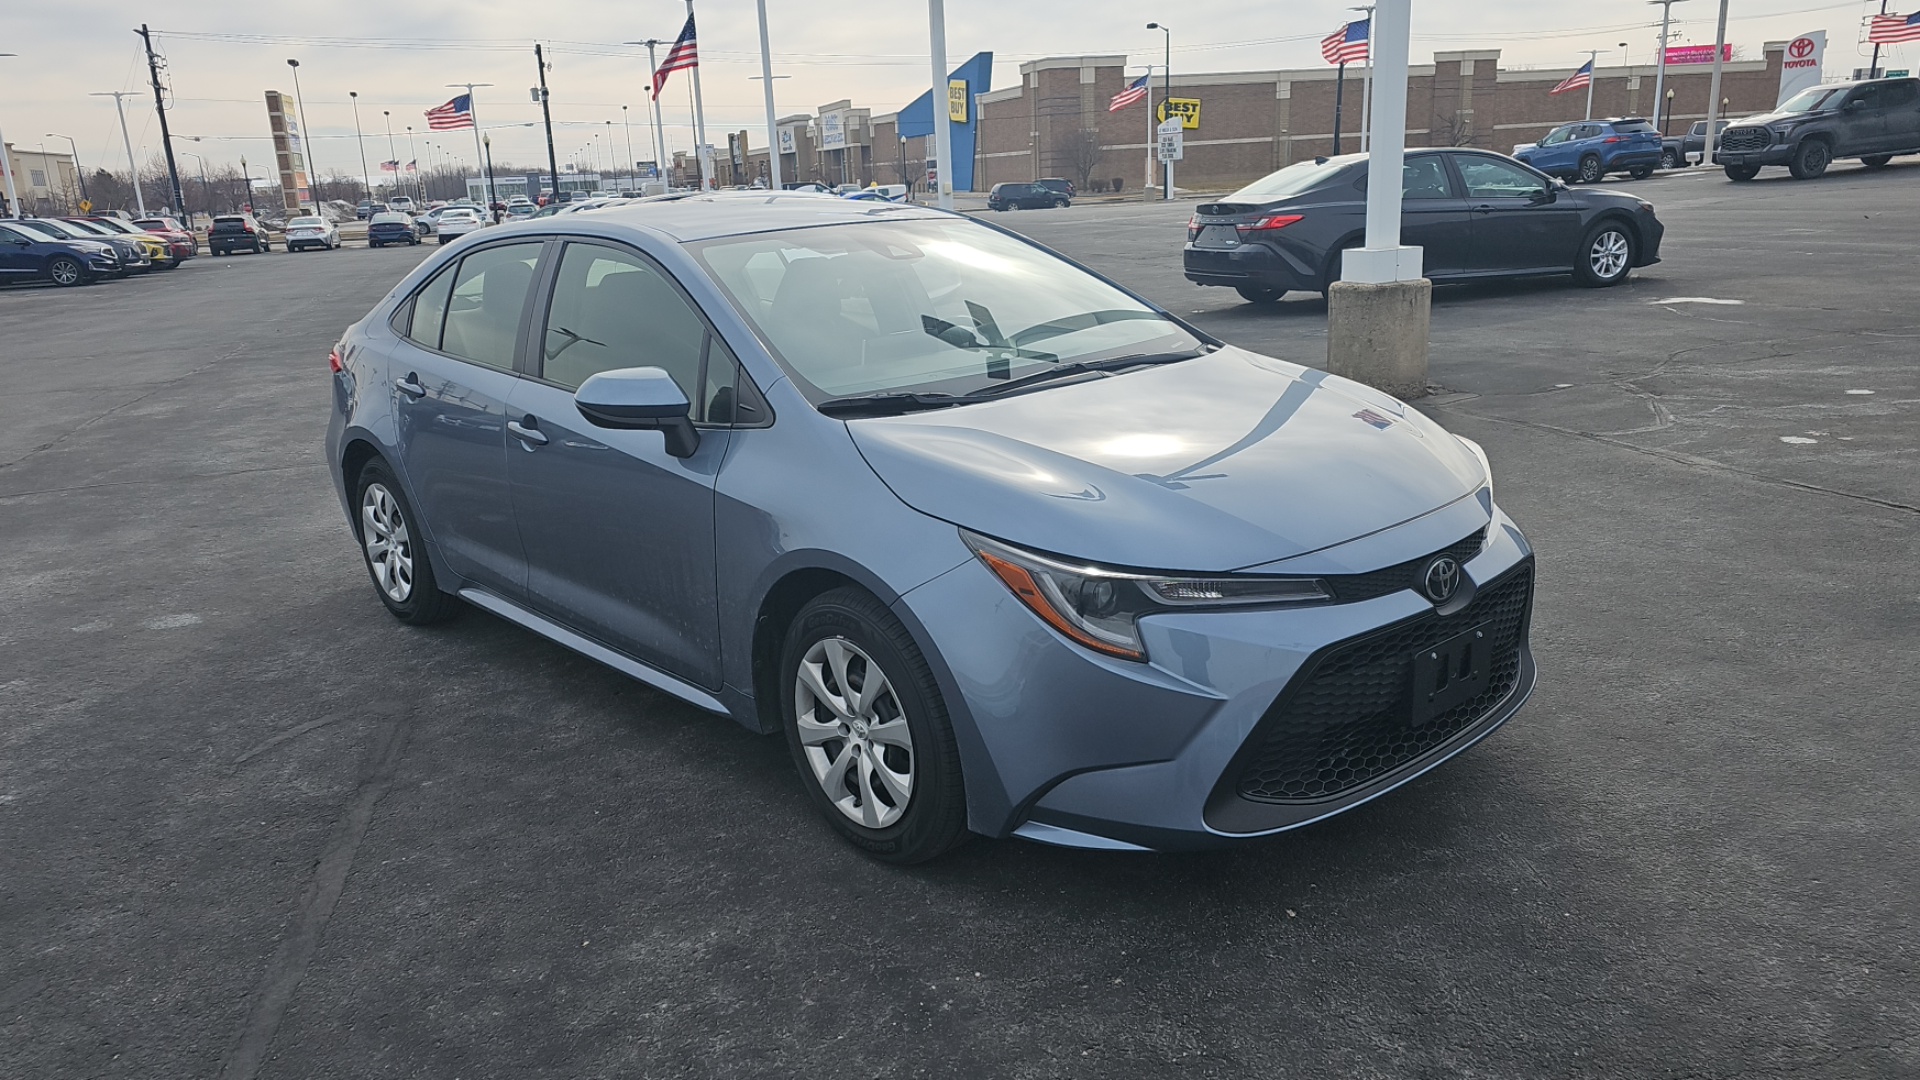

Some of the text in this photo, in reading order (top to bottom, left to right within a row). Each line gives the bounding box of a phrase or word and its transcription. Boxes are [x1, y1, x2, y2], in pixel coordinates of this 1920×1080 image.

[1783, 59, 1817, 69] TOYOTA
[950, 86, 965, 100] BEST
[950, 100, 964, 114] BUY
[1164, 102, 1199, 113] BEST
